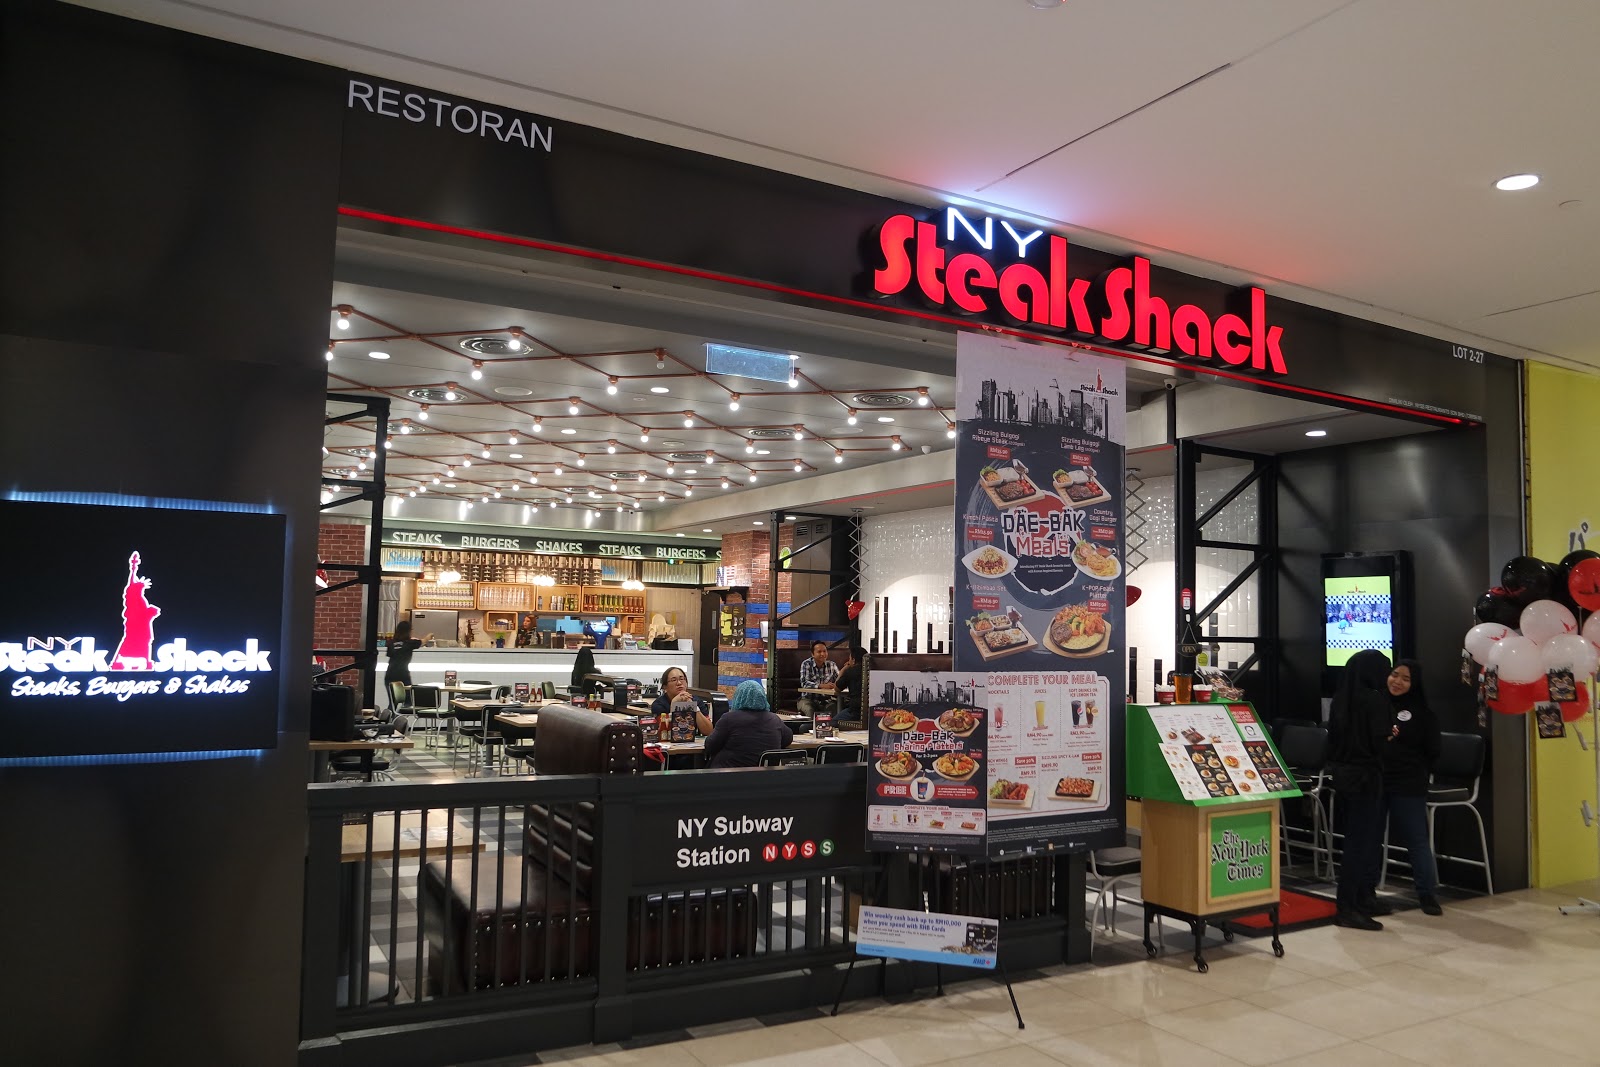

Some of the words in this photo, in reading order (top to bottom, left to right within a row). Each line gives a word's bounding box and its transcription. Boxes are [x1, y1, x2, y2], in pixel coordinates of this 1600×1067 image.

[348, 80, 553, 153] RESTORAN
[947, 207, 1044, 258] NY
[874, 214, 1095, 334] Steak
[1101, 256, 1288, 375] Shack
[1452, 346, 1468, 359] LOT
[1469, 350, 1484, 363] 2-27
[977, 428, 999, 437] Sizzling
[1000, 432, 1020, 440] Bulgogi
[1061, 436, 1081, 445] Sizzling
[392, 531, 443, 545] STEAKS
[461, 535, 520, 550] BURGERS
[535, 540, 583, 554] SHAKES
[598, 544, 642, 557] STEAKS
[656, 547, 706, 559] BURGERS
[1016, 535, 1070, 556] Meals
[27, 636, 83, 651] NY
[1181, 645, 1197, 654] OPEN
[153, 637, 272, 672] Shack
[85, 676, 162, 702] Burgers
[164, 676, 182, 694] &
[184, 674, 251, 694] Shakes
[987, 674, 1040, 686] COMPLETE
[1041, 674, 1069, 685] YOUR
[1071, 674, 1097, 685] MEAL
[902, 731, 955, 741] Dae-Bak
[893, 743, 925, 752] Sharing
[927, 741, 964, 750] Platters
[883, 785, 907, 795] FREE
[677, 817, 709, 839] NY
[713, 815, 794, 836] Subway
[1222, 829, 1240, 847] The
[676, 845, 750, 868] Station
[1211, 842, 1238, 866] New
[1238, 836, 1270, 864] York
[1226, 862, 1265, 883] Times
[863, 910, 874, 918] Win
[875, 913, 893, 921] weekly
